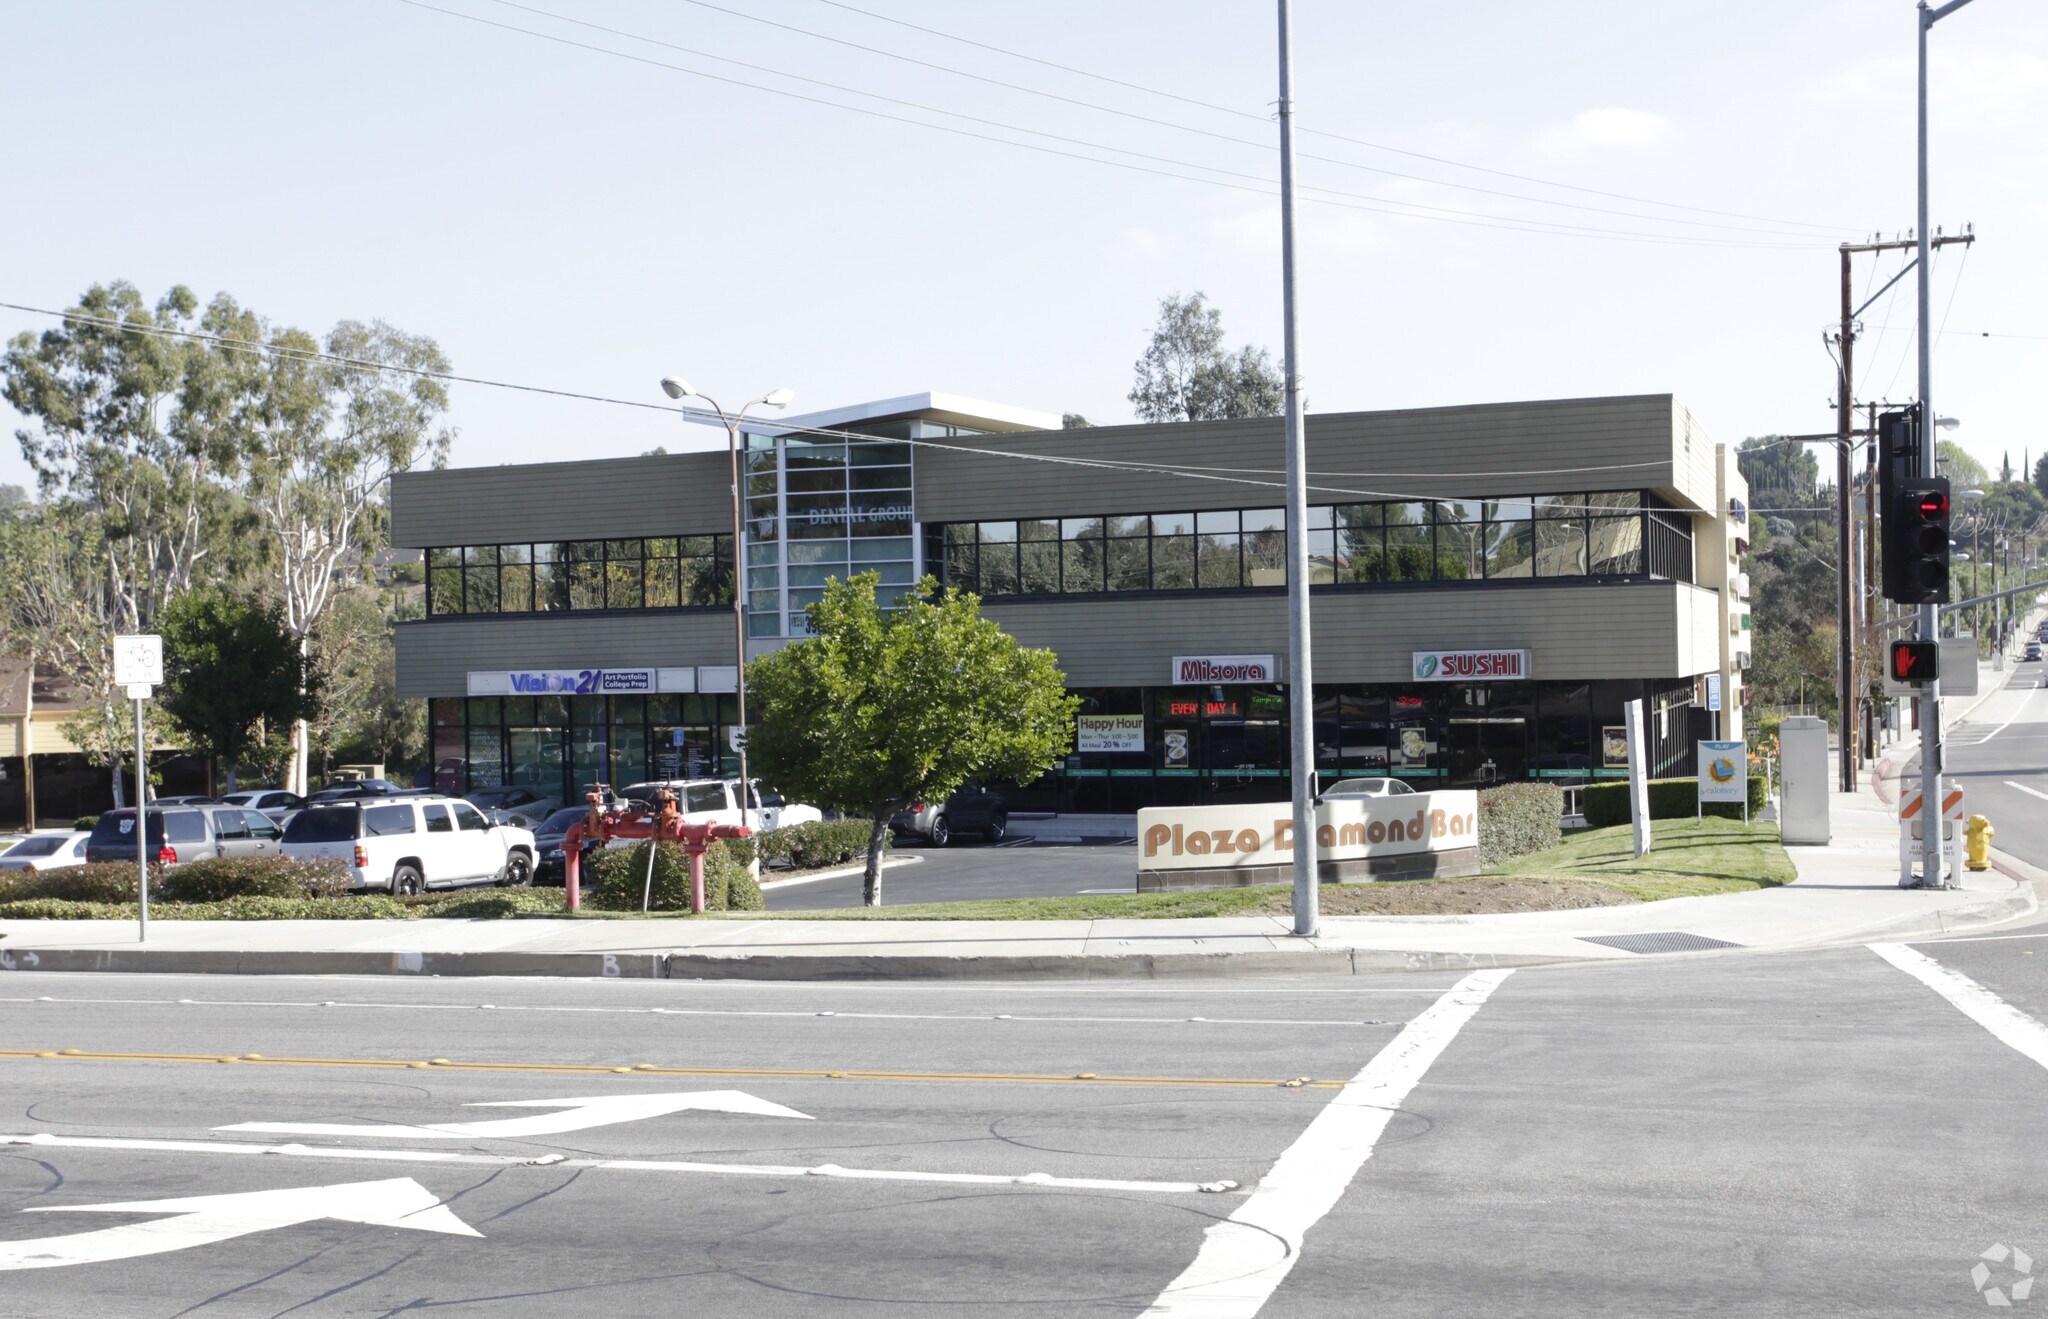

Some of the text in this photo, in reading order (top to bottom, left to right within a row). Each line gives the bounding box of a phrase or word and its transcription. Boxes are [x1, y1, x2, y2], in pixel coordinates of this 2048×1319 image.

[809, 506, 865, 525] DENTAL
[1180, 660, 1264, 681] Misora
[1441, 654, 1517, 676] SUSHI
[575, 670, 602, 694] 21
[604, 680, 648, 689] College Prep
[616, 673, 647, 681] Portfolio
[1171, 703, 1198, 714] EVER
[1206, 703, 1227, 714] DAY
[1080, 717, 1143, 731] Happy Hour
[1144, 808, 1474, 857] Plaza Damond Bar
